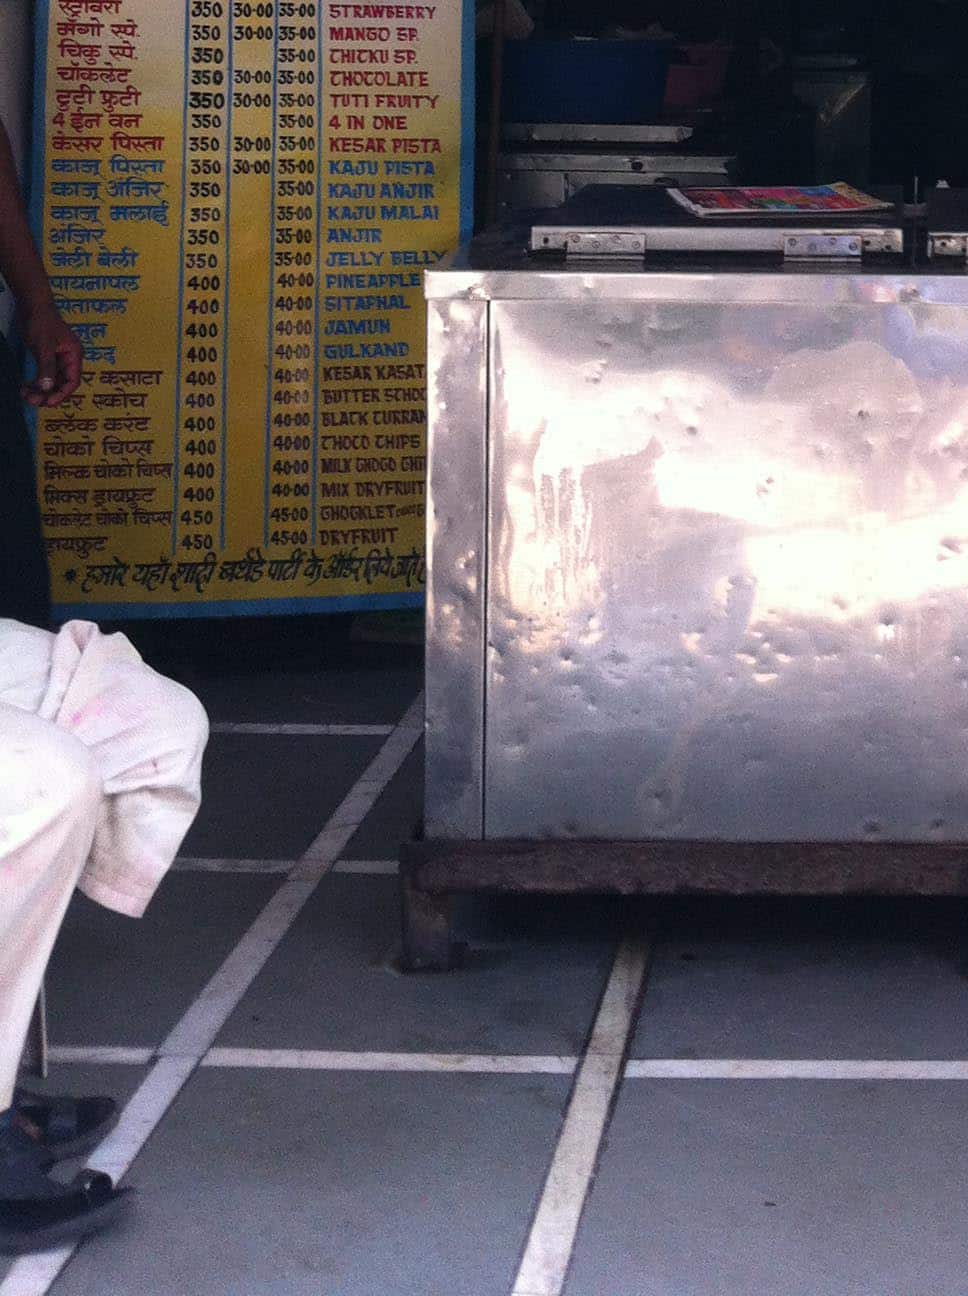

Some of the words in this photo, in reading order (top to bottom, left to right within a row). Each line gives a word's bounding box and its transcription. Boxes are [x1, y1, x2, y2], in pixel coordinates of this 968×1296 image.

[192, 1, 222, 18] 350
[329, 5, 436, 19] STRAWBERRY
[192, 24, 221, 41] 350
[329, 27, 391, 42] MANGO
[192, 48, 224, 64] 350
[192, 70, 223, 85] 350
[330, 72, 429, 87] CHOCOLATE
[189, 92, 225, 110] 350
[329, 95, 369, 108] TUTI
[53, 113, 64, 127] 4
[192, 114, 222, 129] 350
[329, 115, 341, 129] 4
[347, 116, 364, 129] IN
[373, 116, 408, 130] ONE
[189, 137, 220, 152] 350
[329, 138, 386, 153] KESAR
[392, 138, 442, 153] PISTA
[191, 159, 221, 175] 350
[328, 161, 379, 175] KAJU
[384, 161, 435, 175] PISTA
[190, 183, 221, 198] 350
[328, 184, 375, 199] KAJU
[380, 184, 434, 199] ANJIR
[190, 207, 221, 223] 350
[328, 206, 376, 220] KAJU
[381, 206, 439, 220] MALAI
[188, 229, 219, 245] 350
[327, 229, 382, 243] ANJIR
[186, 254, 218, 269] 350
[326, 252, 384, 267] JELLY
[187, 275, 220, 291] 400
[326, 274, 421, 289] PINEAPPLE
[186, 299, 219, 314] 400
[186, 323, 218, 338] 400
[324, 320, 390, 335] JAMUN
[187, 347, 217, 362] 400
[323, 343, 409, 359] GULKAND
[186, 371, 216, 386] 400
[323, 366, 372, 381] KESAR
[186, 393, 215, 408] 400
[322, 389, 380, 404] BUTTER
[184, 416, 215, 431] 400
[322, 412, 368, 426] BLACK
[185, 439, 216, 455] 400
[321, 435, 369, 450] CHOCO
[375, 435, 420, 449] CHIPS
[184, 463, 215, 478] 400
[183, 487, 215, 502] 400
[321, 482, 349, 497] MIX
[181, 510, 212, 525] 450
[182, 534, 212, 550] 450
[319, 528, 398, 545] DRYFRUIT
